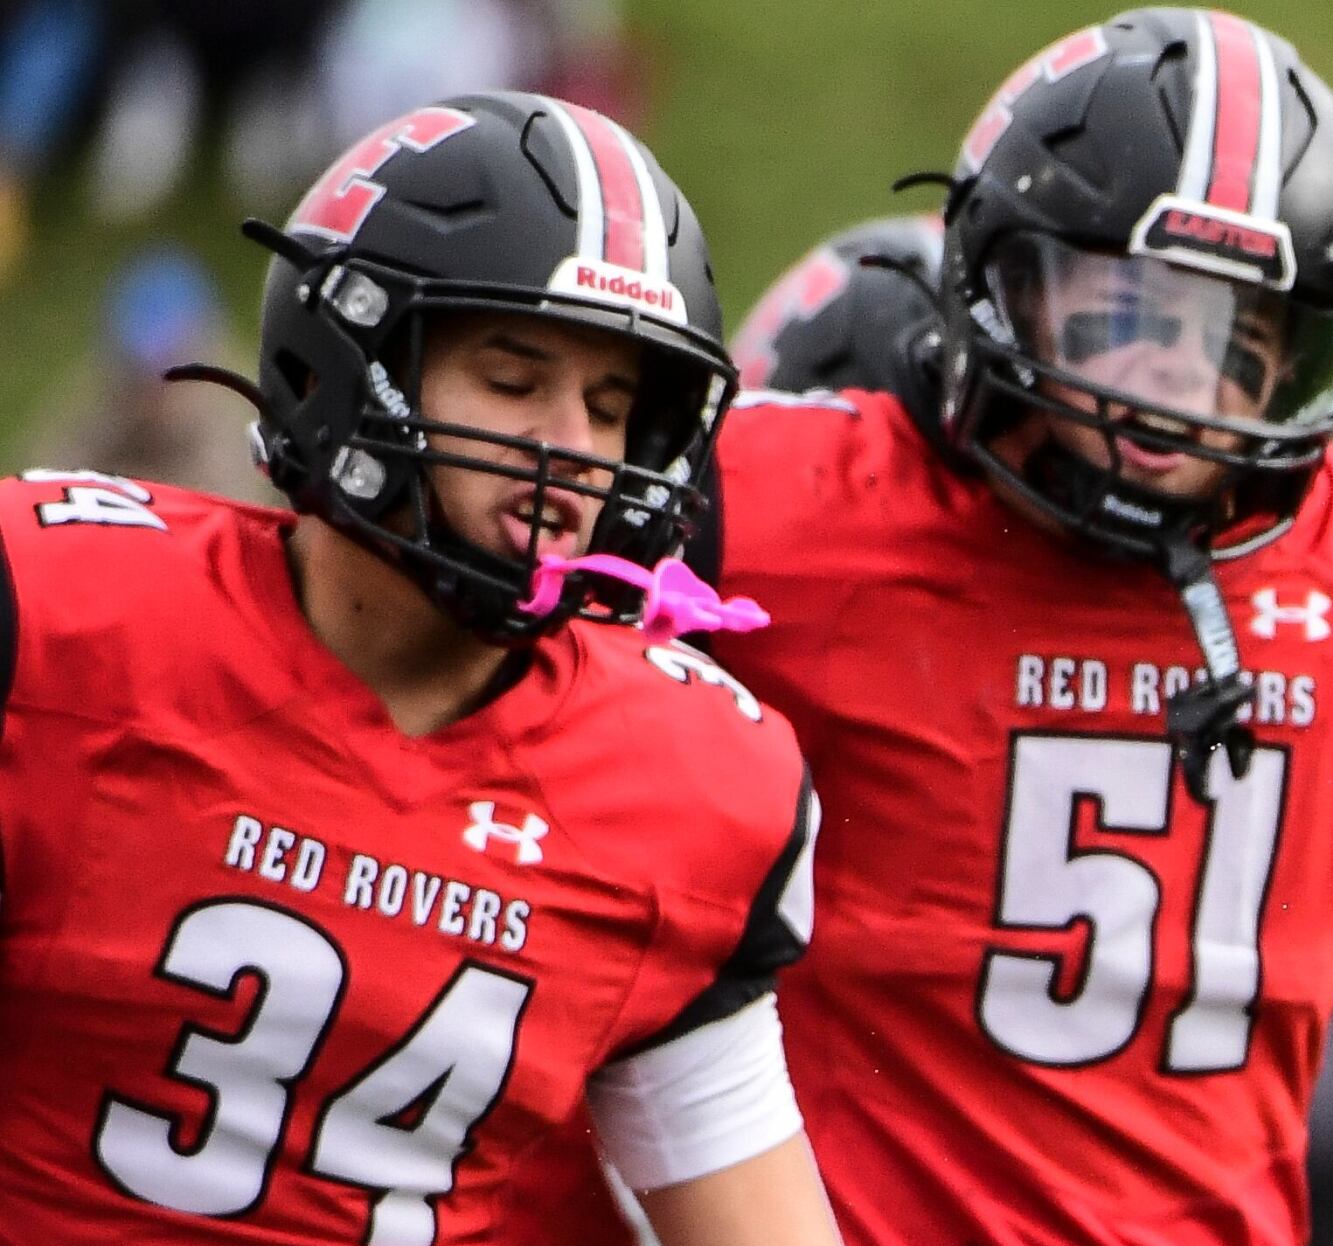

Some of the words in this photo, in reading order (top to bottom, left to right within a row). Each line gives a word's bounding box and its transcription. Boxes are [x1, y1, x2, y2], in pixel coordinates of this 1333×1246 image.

[576, 266, 674, 311] Riddell
[645, 638, 765, 722] 3
[1016, 655, 1108, 712] RED
[225, 814, 325, 895] RED
[344, 854, 530, 953] ROVERS
[975, 728, 1291, 1077] 51
